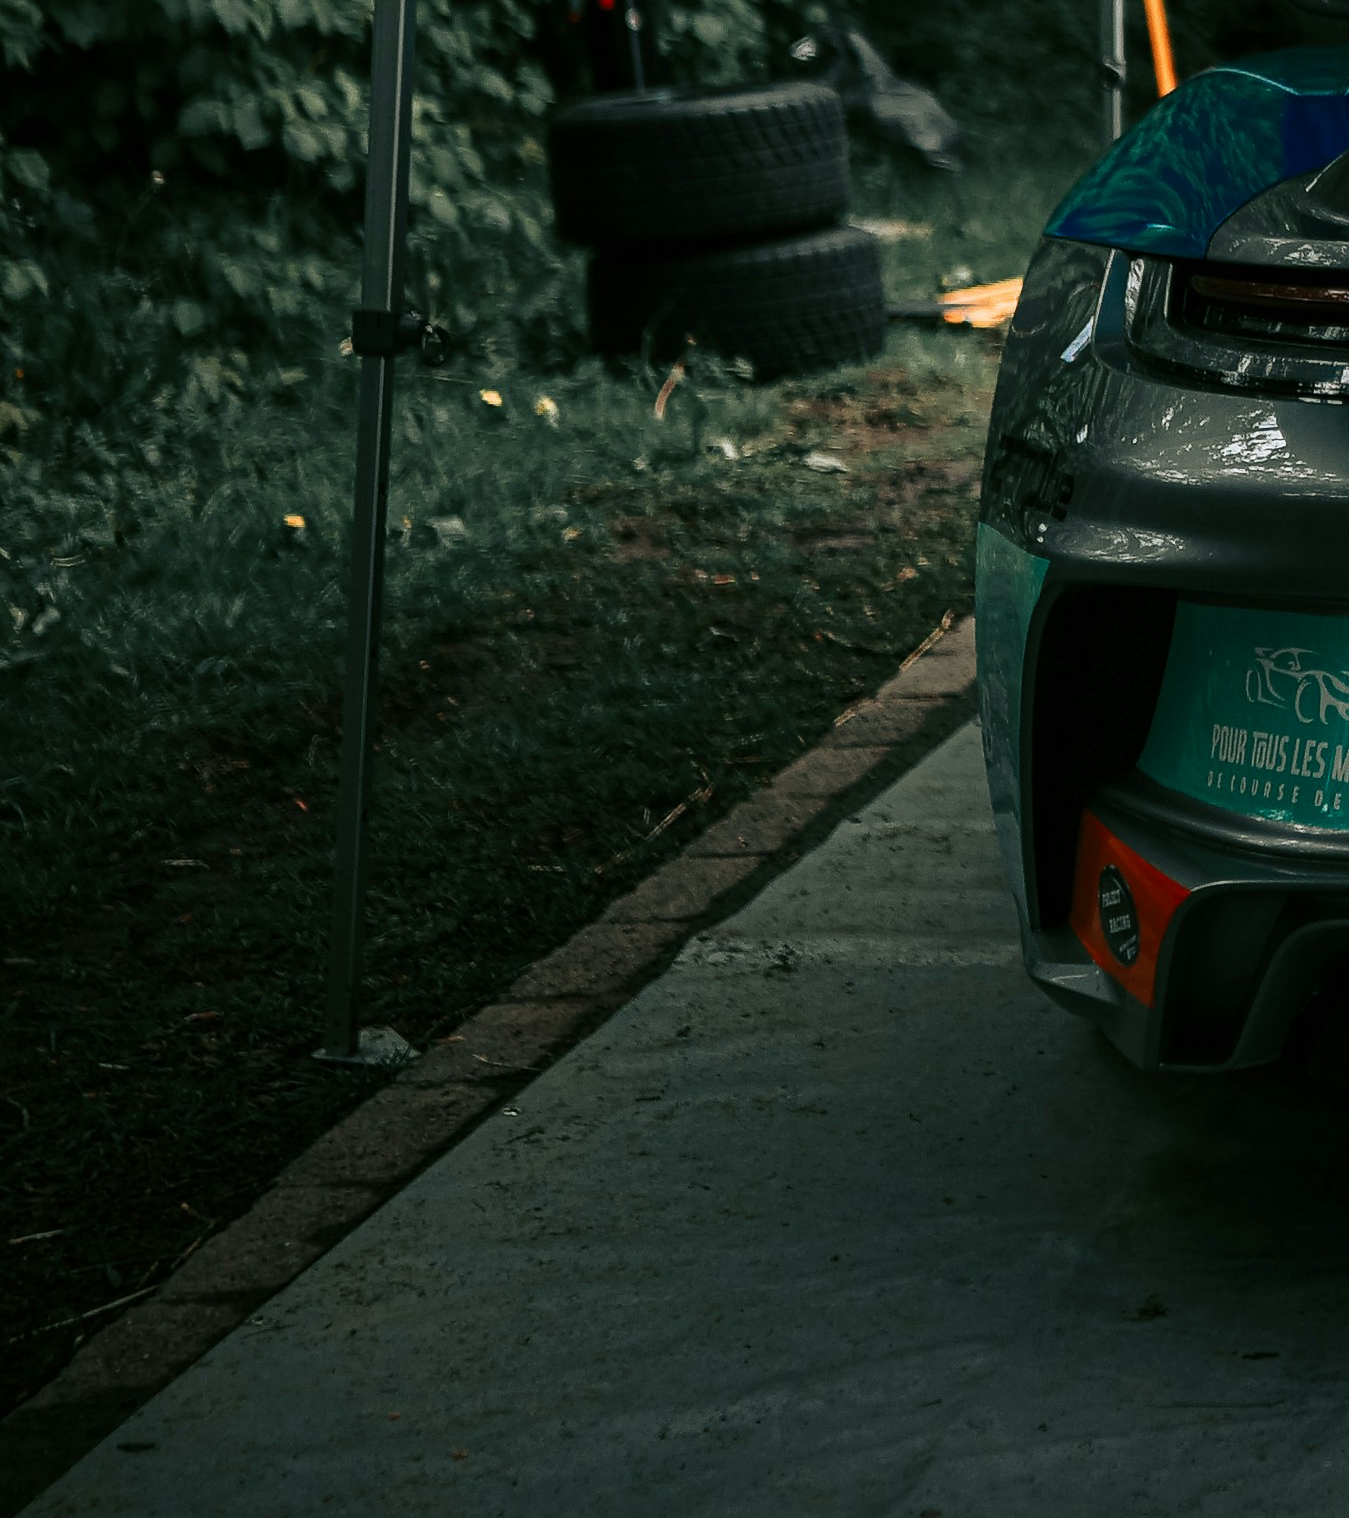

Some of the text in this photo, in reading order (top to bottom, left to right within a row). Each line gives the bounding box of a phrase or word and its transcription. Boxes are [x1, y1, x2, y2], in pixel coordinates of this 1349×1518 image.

[1210, 723, 1248, 766] POUR
[1250, 730, 1290, 773] TOUS
[1290, 738, 1329, 779] LES
[1207, 770, 1223, 789] DE
[1230, 774, 1299, 803] COURSE
[1314, 789, 1342, 811] DE
